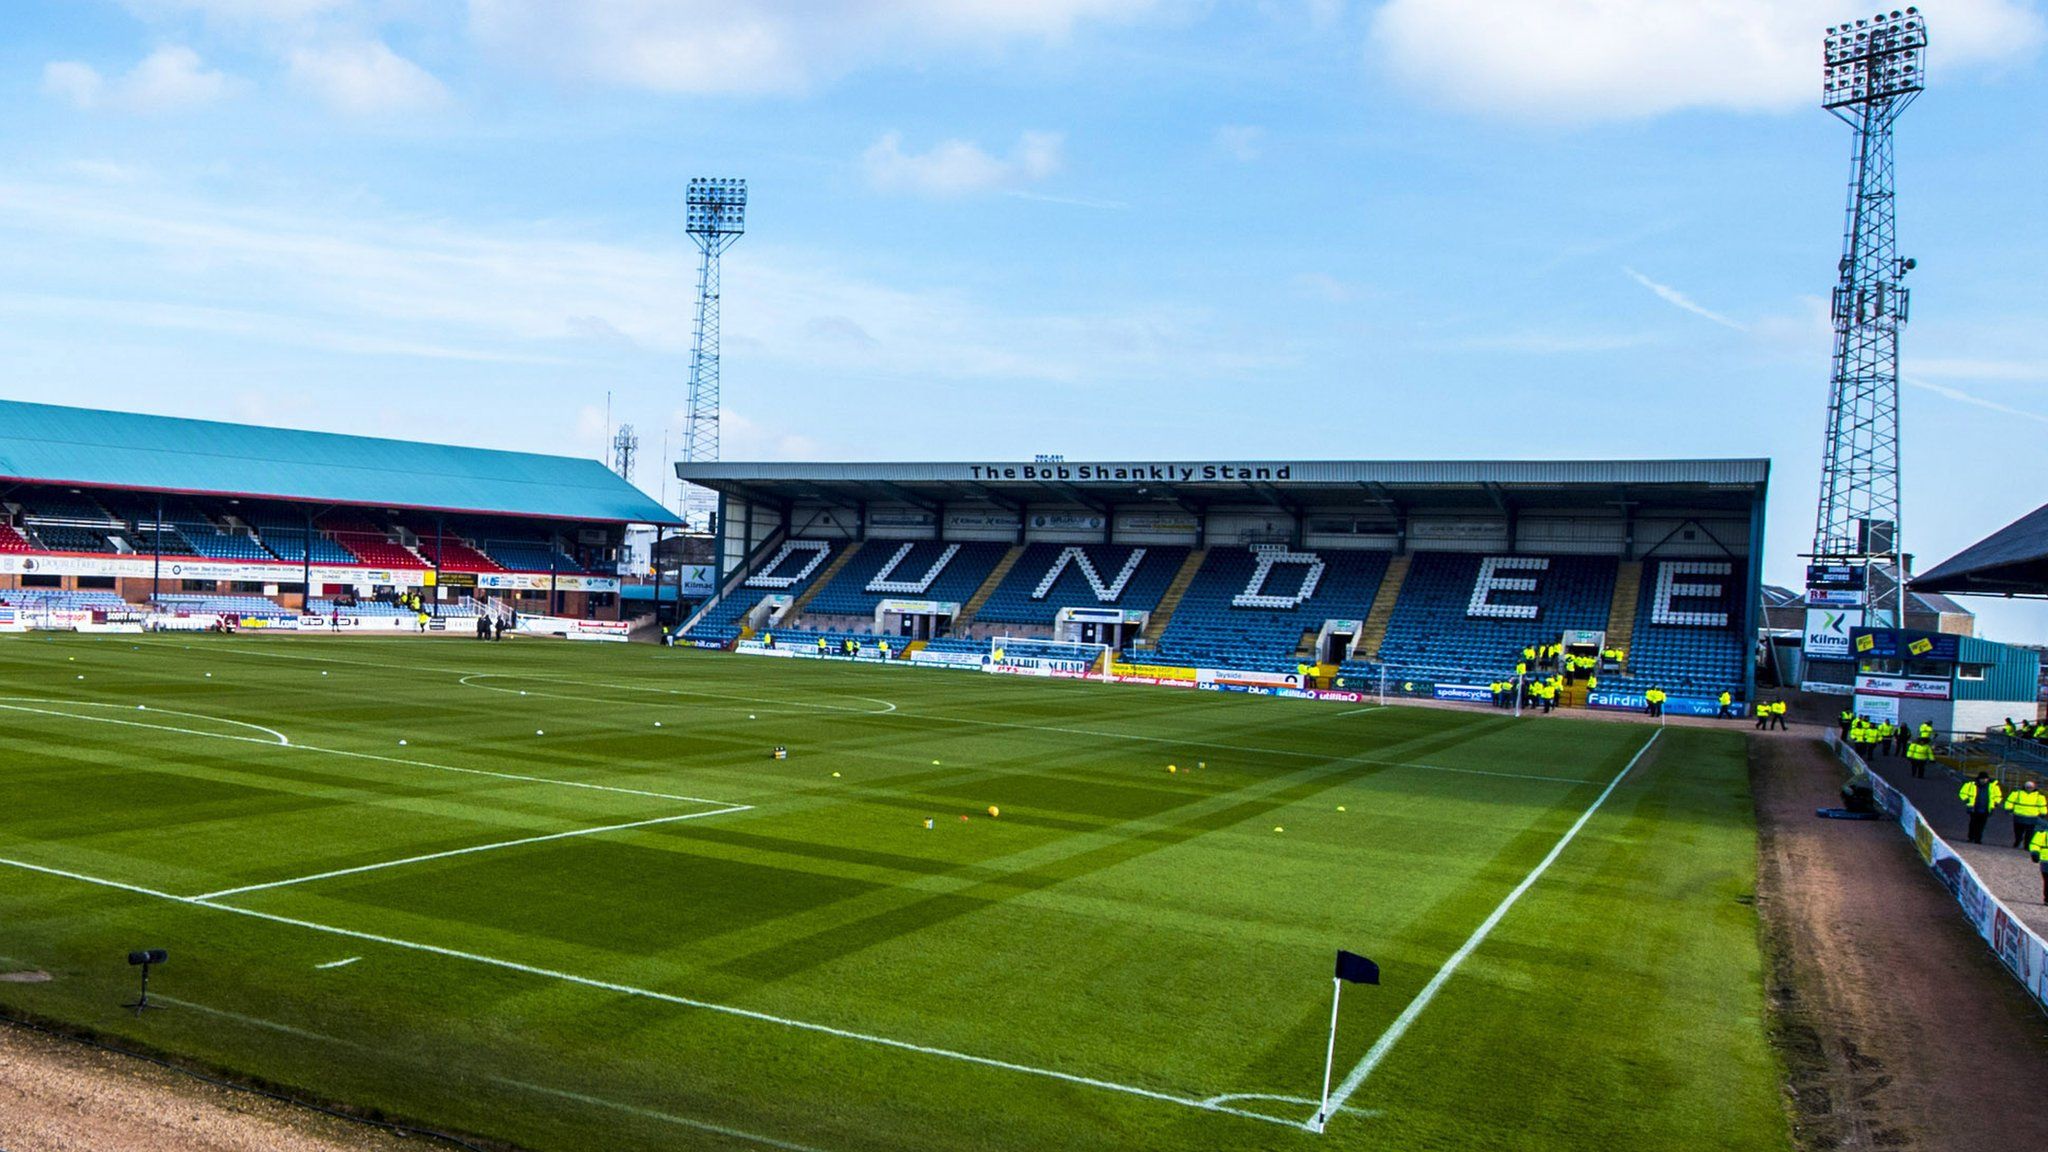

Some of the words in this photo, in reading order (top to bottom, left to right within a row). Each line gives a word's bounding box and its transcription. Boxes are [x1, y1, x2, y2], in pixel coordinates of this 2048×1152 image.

[970, 465, 1016, 480] The
[1023, 465, 1070, 480] Bob
[1078, 465, 1195, 482] Shankly
[1202, 464, 1291, 480] Stand
[684, 581, 714, 590] Kilmac
[1215, 670, 1242, 680] Tayside
[1199, 681, 1220, 691] blue
[1247, 684, 1269, 695] blue
[1437, 687, 1492, 699] spokescycles
[1693, 705, 1713, 714] Van
